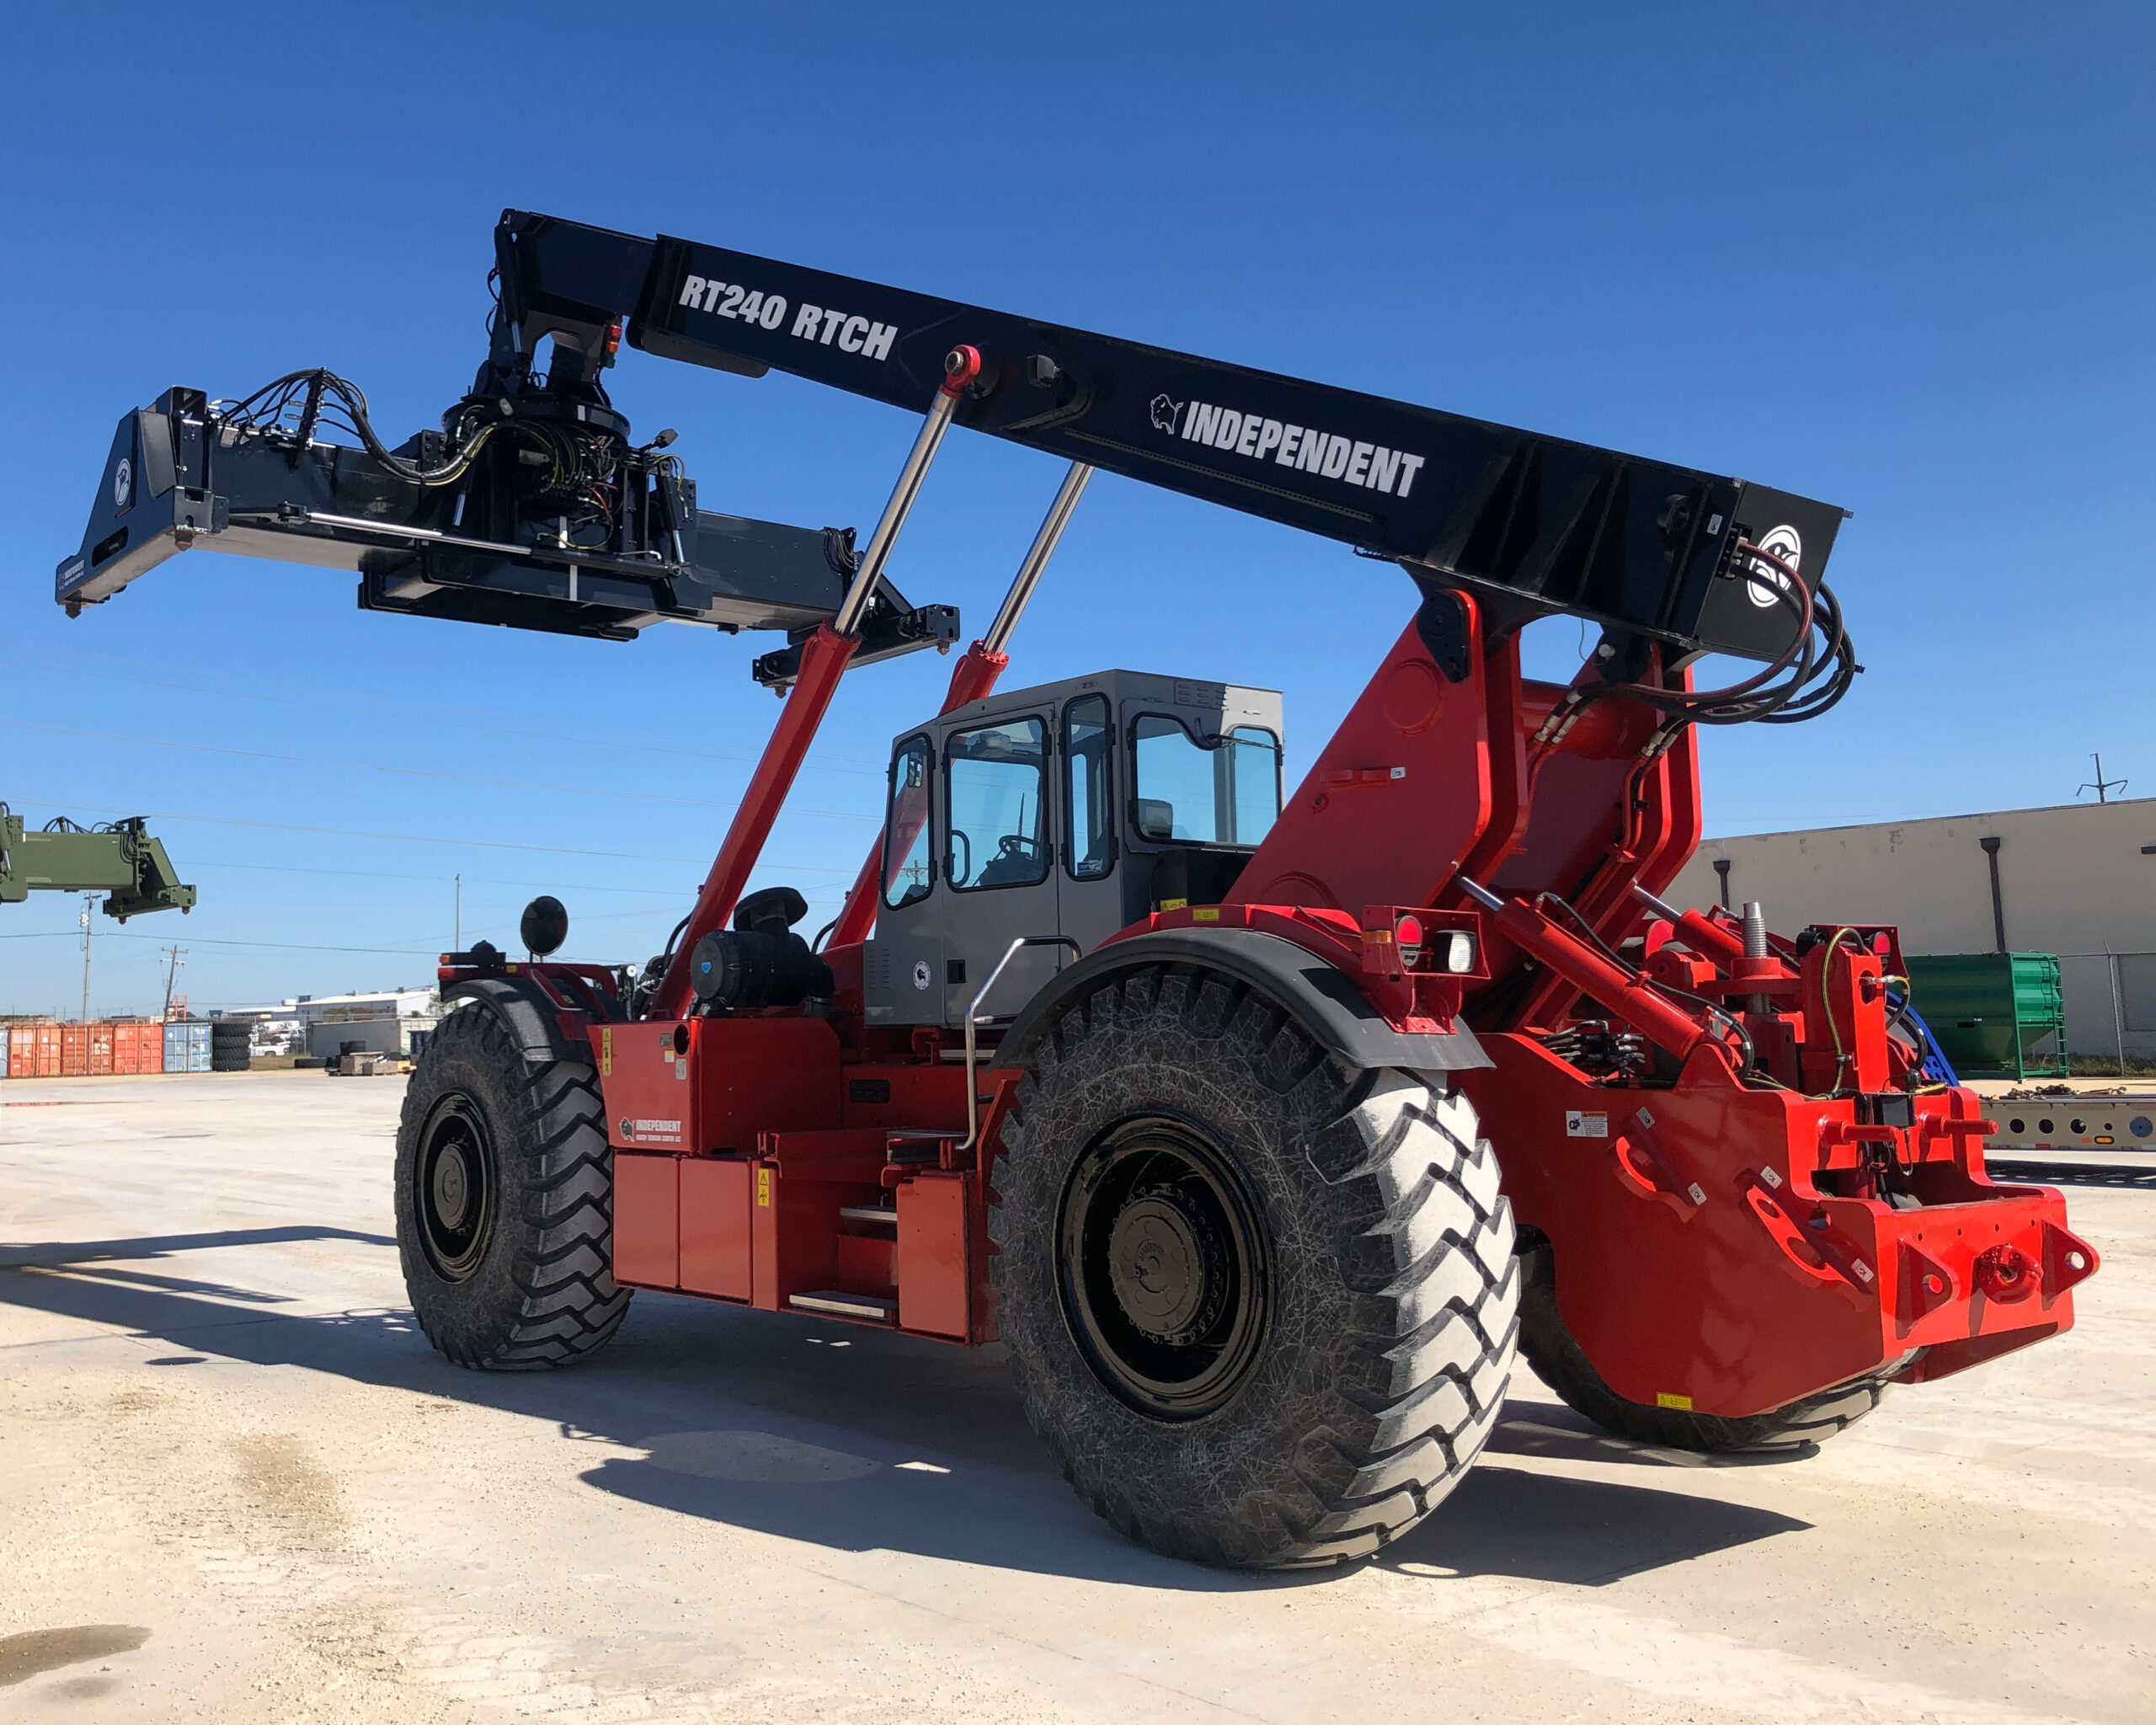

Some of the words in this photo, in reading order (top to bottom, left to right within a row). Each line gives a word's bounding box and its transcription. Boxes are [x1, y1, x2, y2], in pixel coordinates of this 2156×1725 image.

[679, 275, 787, 330] RT240
[791, 303, 899, 361] RTCH
[1181, 401, 1426, 498] INDEPENDENT
